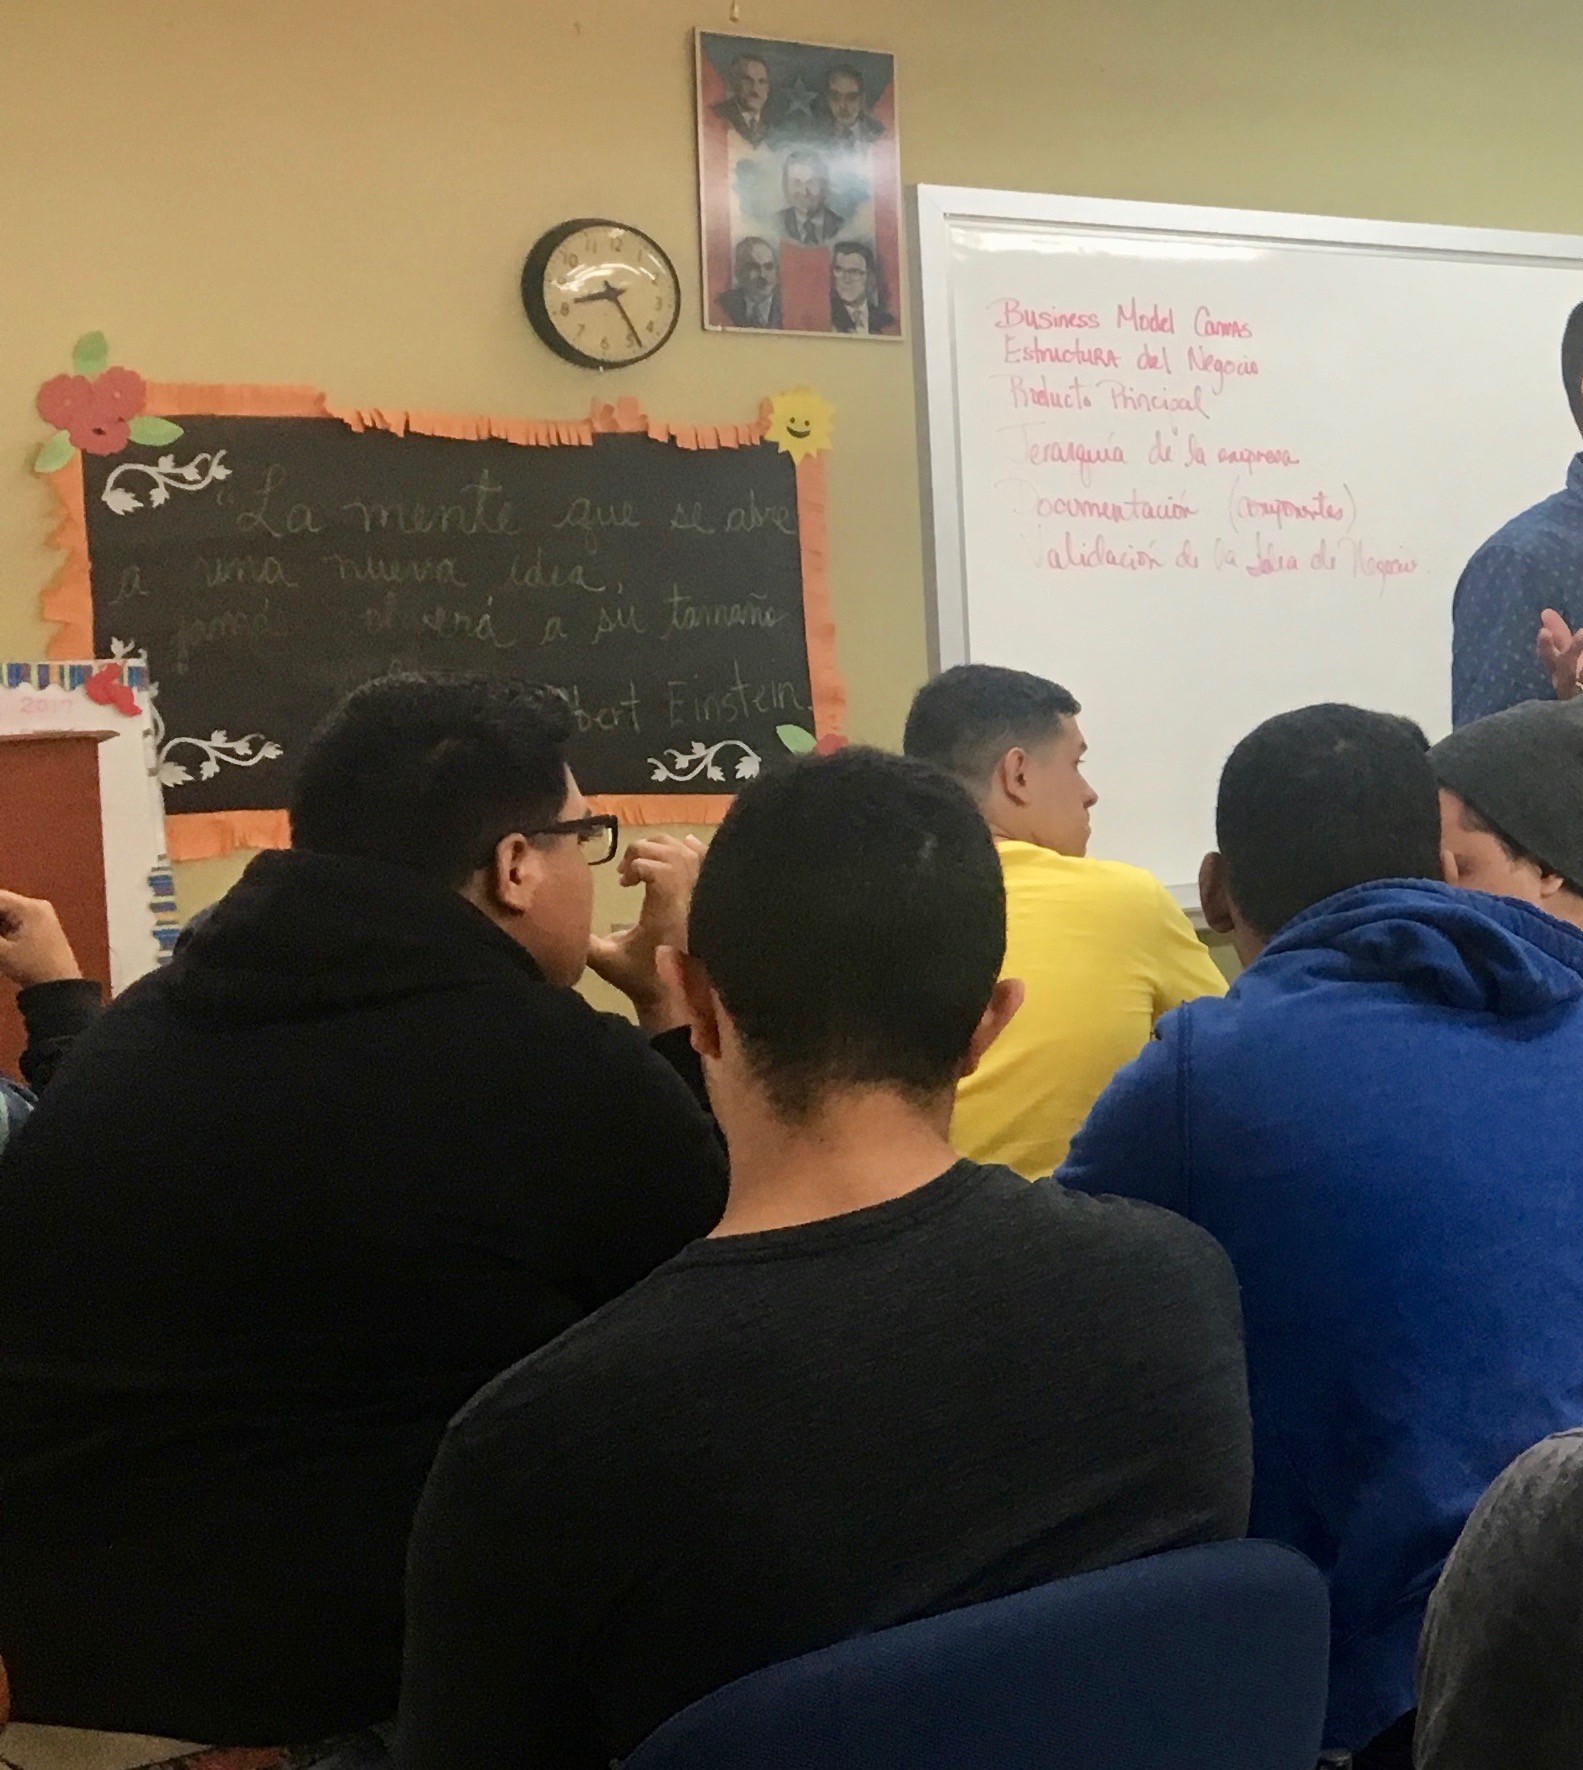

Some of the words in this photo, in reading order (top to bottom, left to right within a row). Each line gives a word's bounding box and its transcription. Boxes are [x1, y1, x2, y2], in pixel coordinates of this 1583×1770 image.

[993, 297, 1100, 331] Business
[1117, 297, 1175, 335] Model
[1137, 343, 1172, 375] del
[341, 468, 521, 538] mente
[552, 497, 641, 555] que
[670, 499, 715, 536] se
[723, 488, 797, 536] abre
[197, 555, 299, 588] una
[323, 552, 467, 588] nueva
[540, 612, 568, 647] a
[591, 602, 646, 645] su
